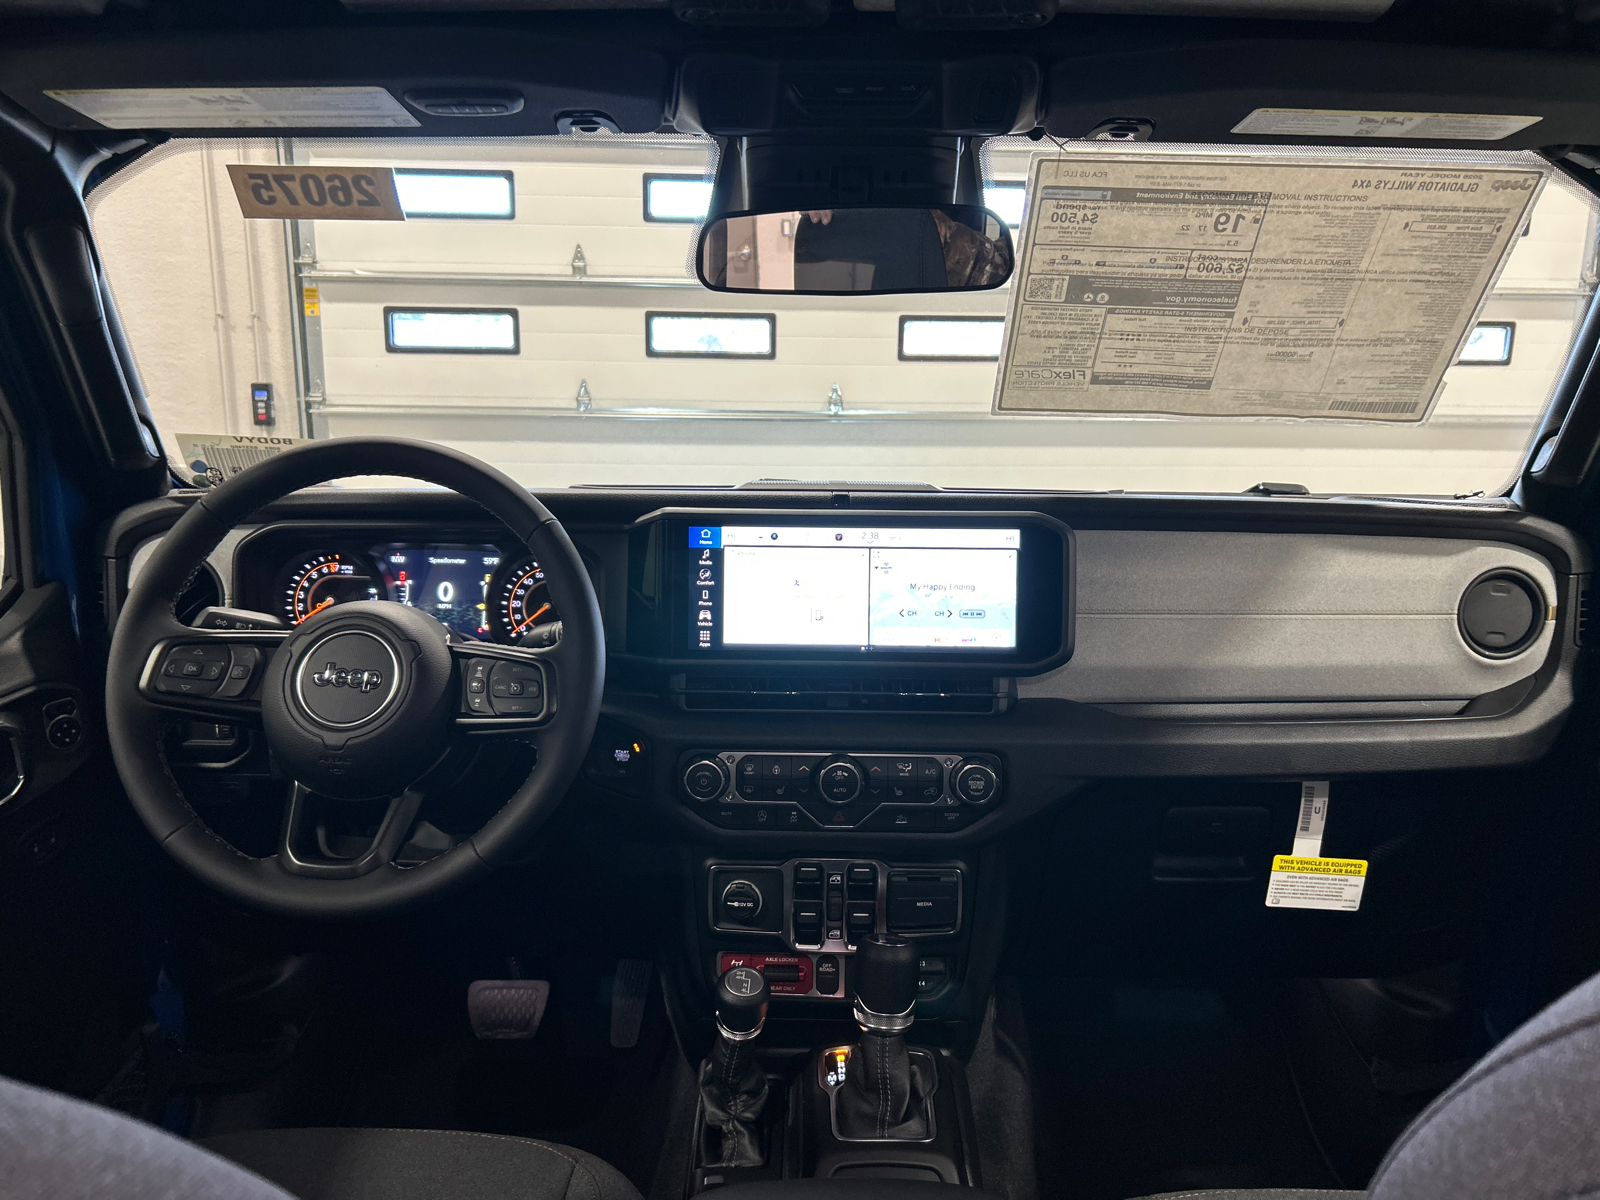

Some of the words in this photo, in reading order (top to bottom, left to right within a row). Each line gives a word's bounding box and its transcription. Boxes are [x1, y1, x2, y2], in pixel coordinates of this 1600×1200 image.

[1304, 194, 1368, 202] INSTRUCTIONS
[862, 532, 879, 540] 238
[438, 581, 454, 603] 0
[910, 584, 921, 592] My
[923, 584, 948, 592] Happy
[950, 584, 976, 592] Ending
[298, 591, 304, 599] 3
[512, 600, 521, 608] 20
[314, 662, 382, 693] Jeep
[1314, 806, 1321, 814] U
